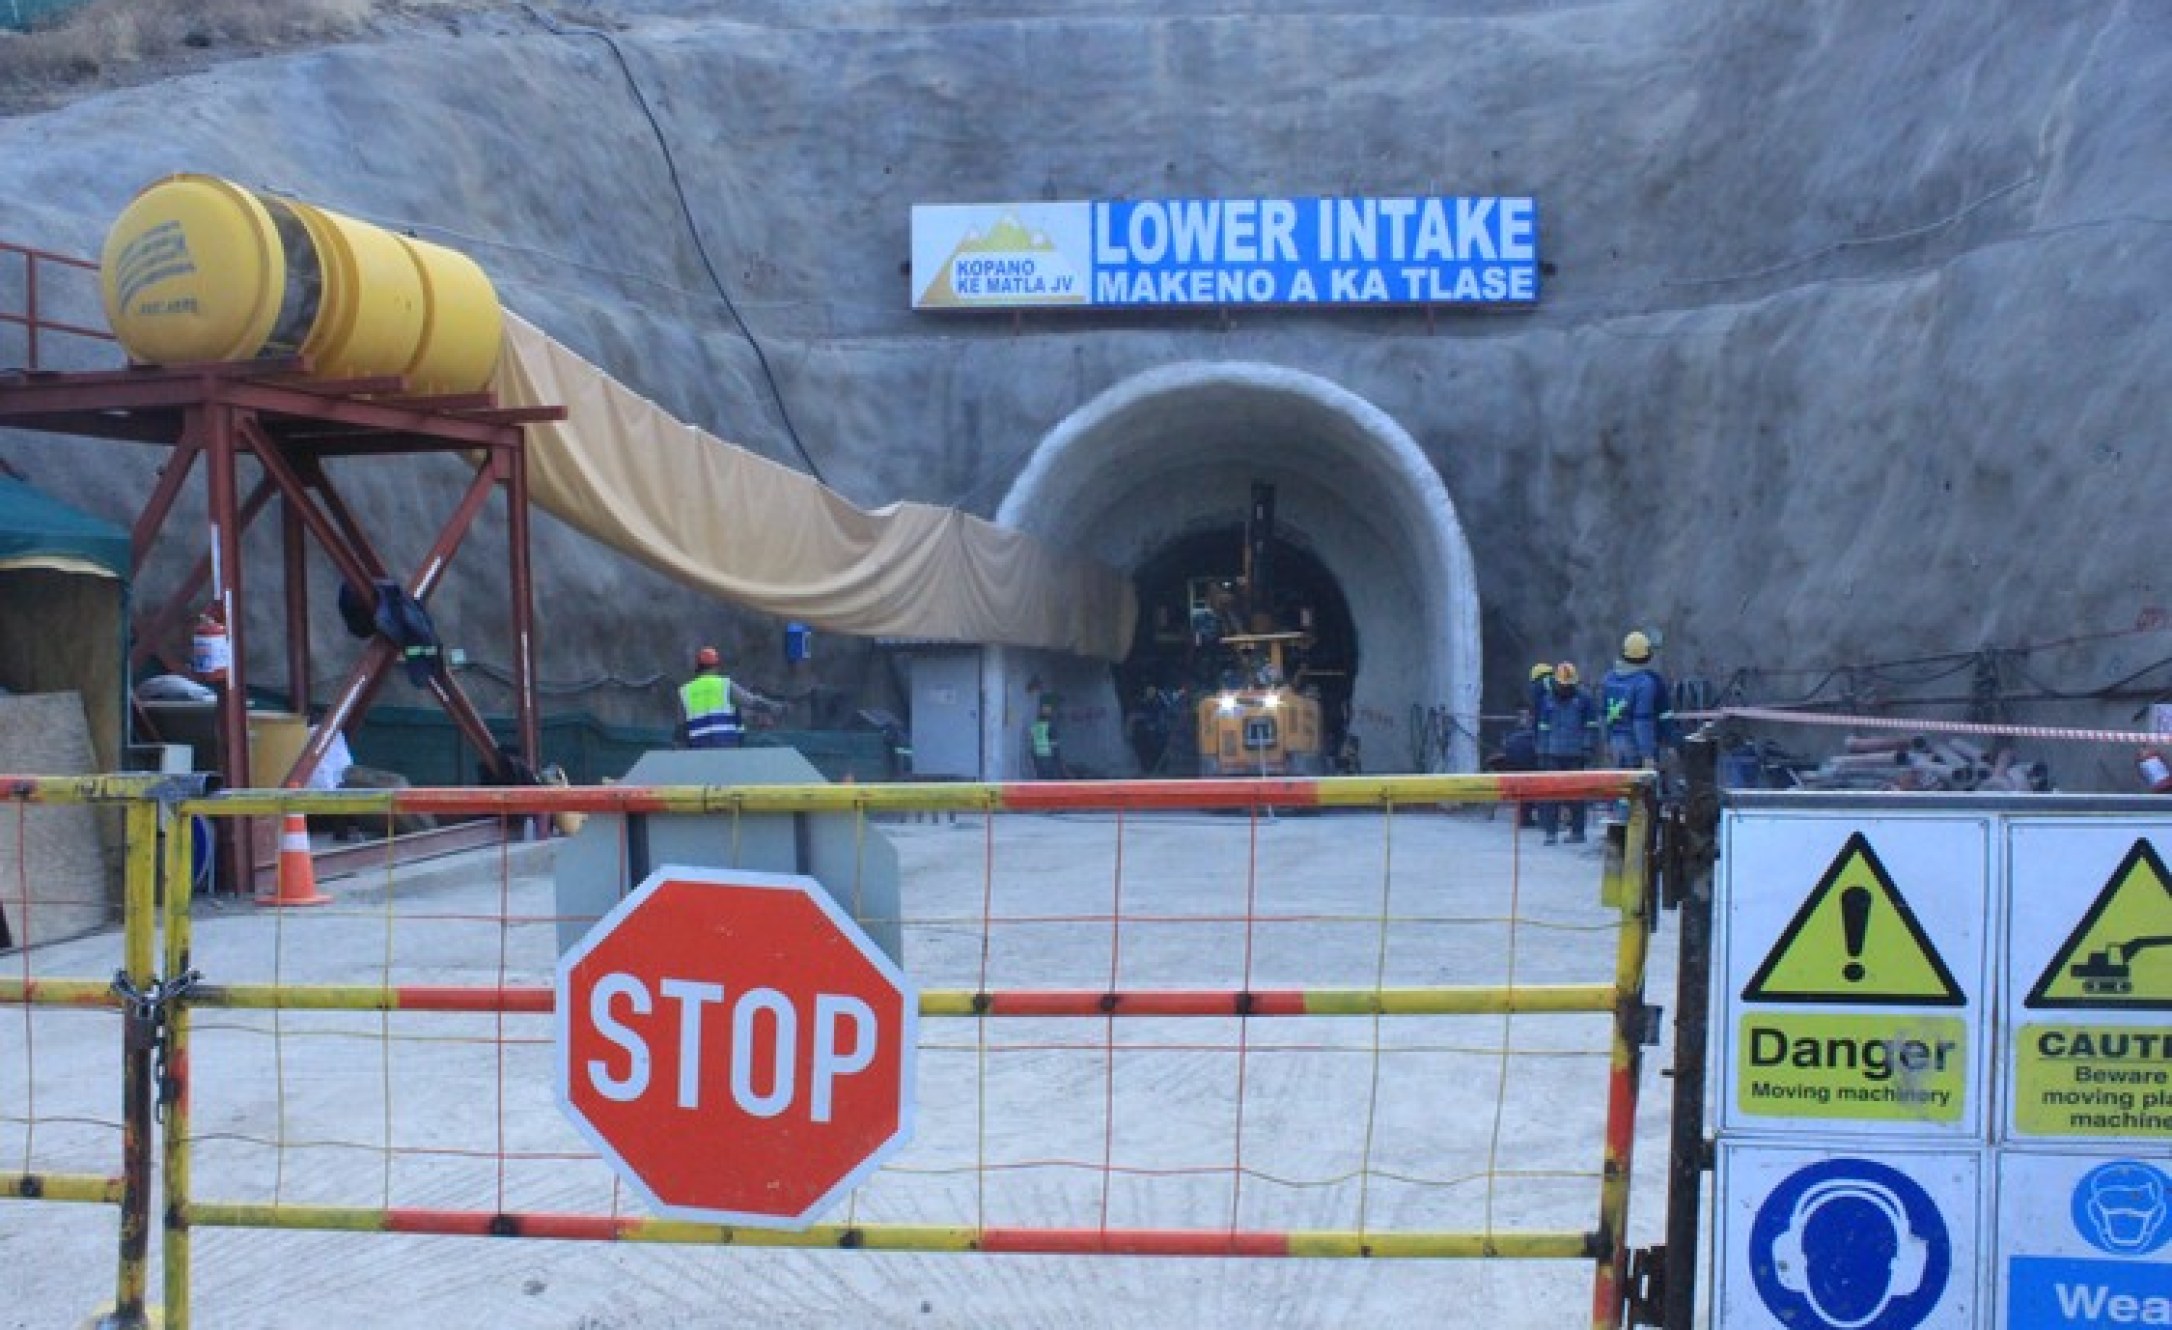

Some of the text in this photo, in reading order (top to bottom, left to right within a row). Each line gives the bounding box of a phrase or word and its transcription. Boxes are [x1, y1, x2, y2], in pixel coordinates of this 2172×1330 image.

[1097, 197, 1533, 264] LOWER INTAKE
[957, 259, 1035, 276] KOPANO
[957, 275, 1073, 293] KE MATLA JV
[1097, 267, 1533, 302] MAKENO A KA TLASE
[587, 972, 878, 1123] STOP
[1750, 1027, 1956, 1081] Danger
[2075, 1066, 2168, 1084] Beware
[1751, 1081, 1950, 1107] Moving machinery
[2042, 1088, 2134, 1110] moving
[2055, 1283, 2170, 1325] Wea
